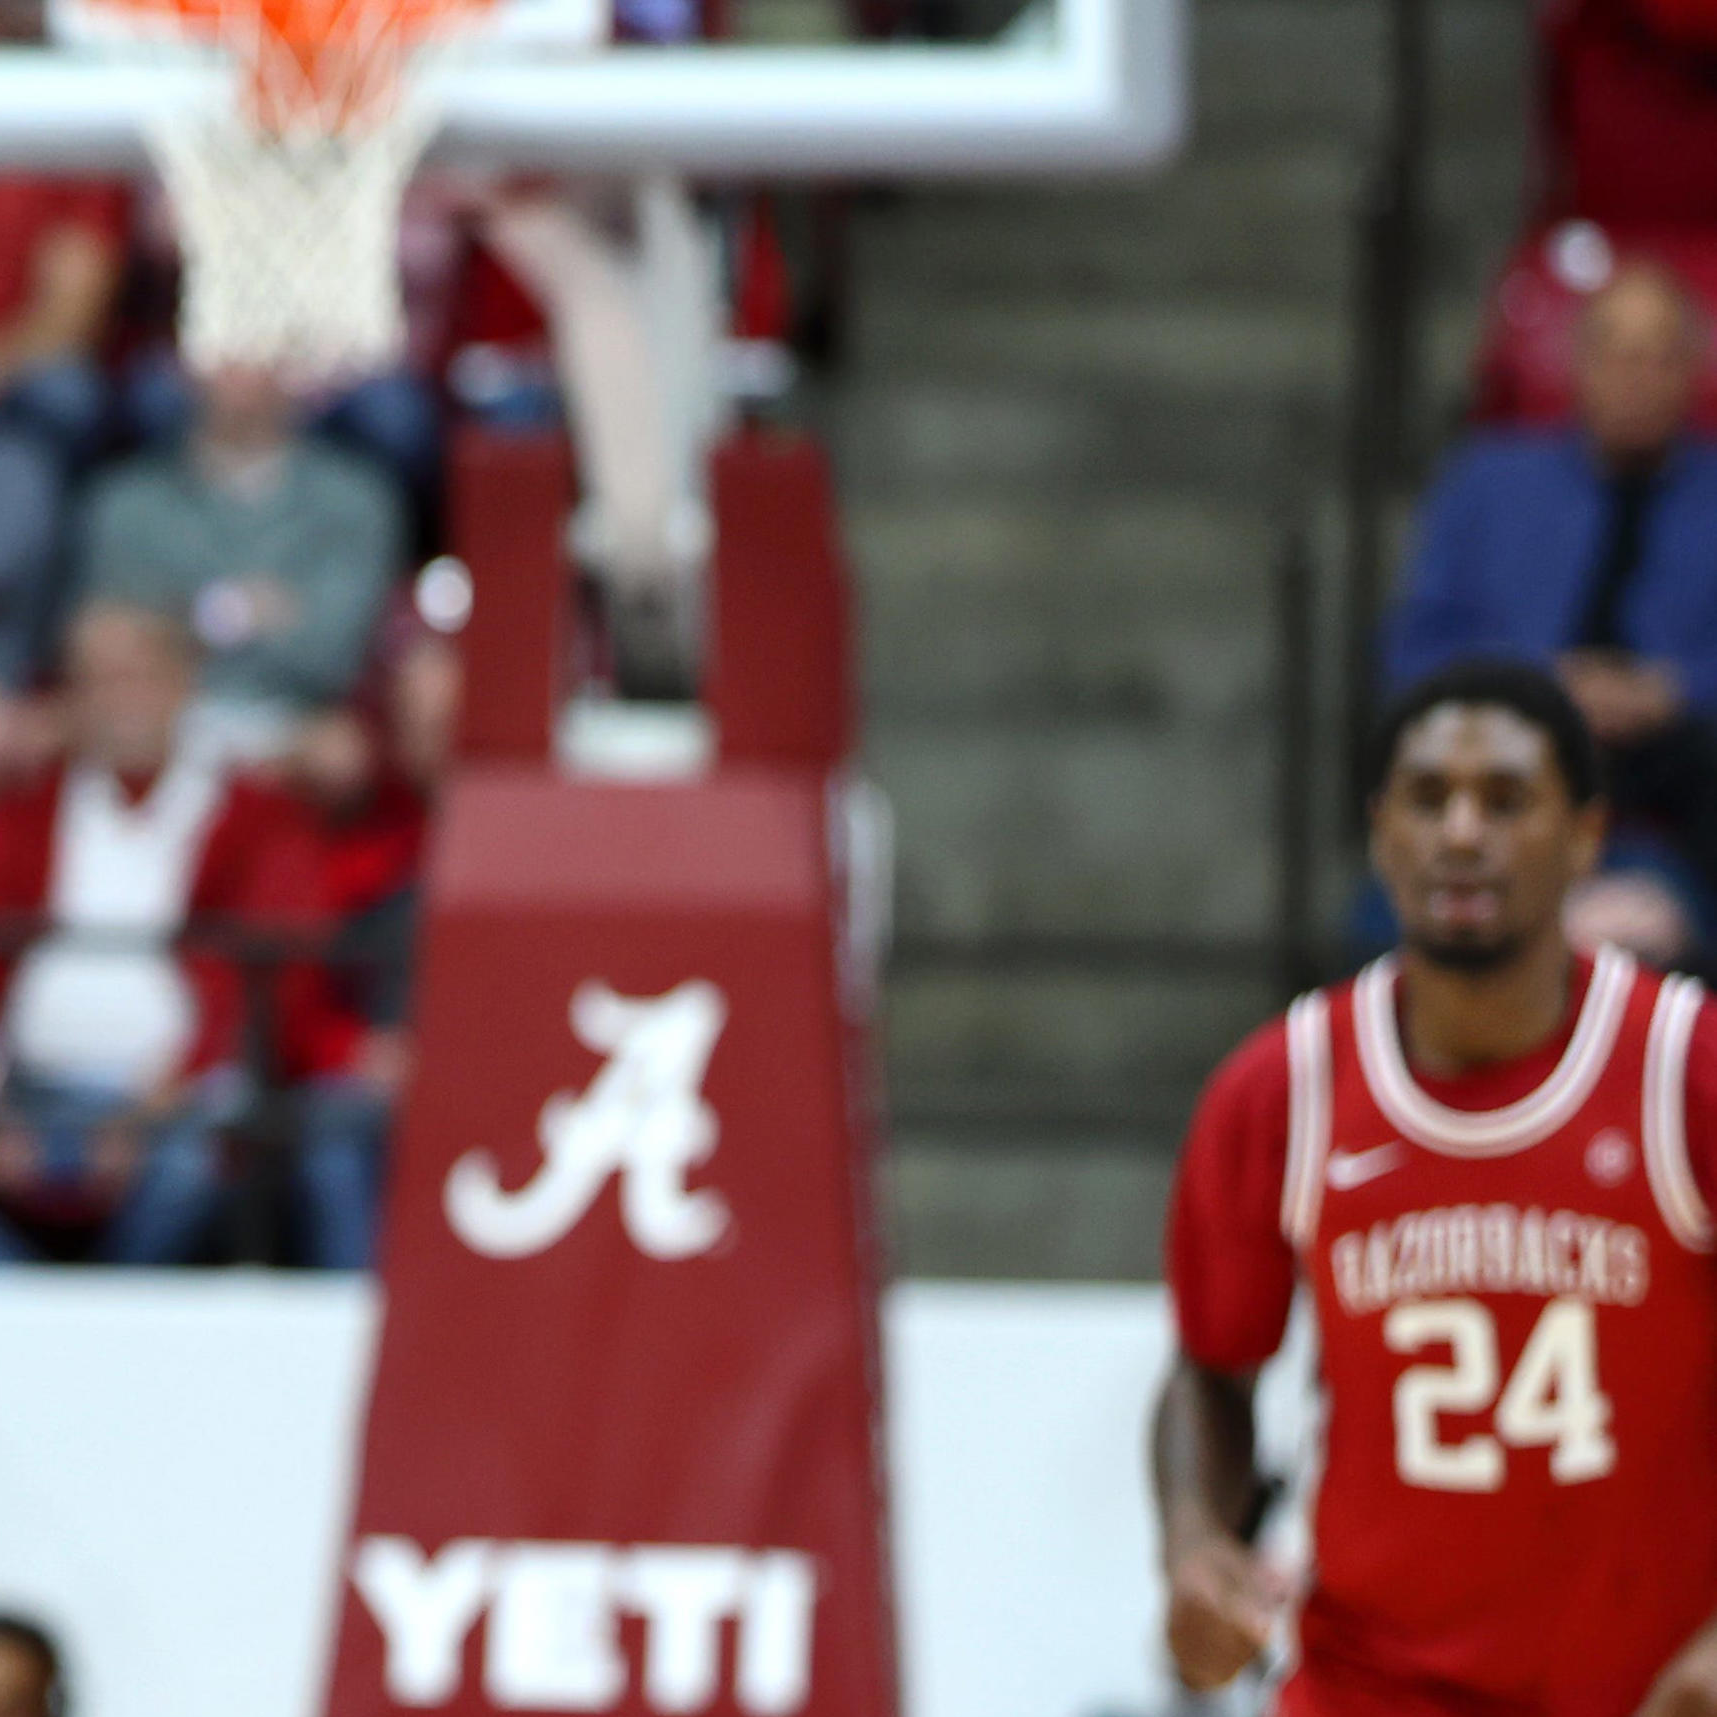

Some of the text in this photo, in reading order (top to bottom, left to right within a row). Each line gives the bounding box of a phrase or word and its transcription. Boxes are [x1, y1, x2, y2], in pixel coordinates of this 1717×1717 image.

[445, 979, 732, 1257] A
[1384, 1294, 1617, 1493] 24
[356, 1536, 816, 1717] YETI
